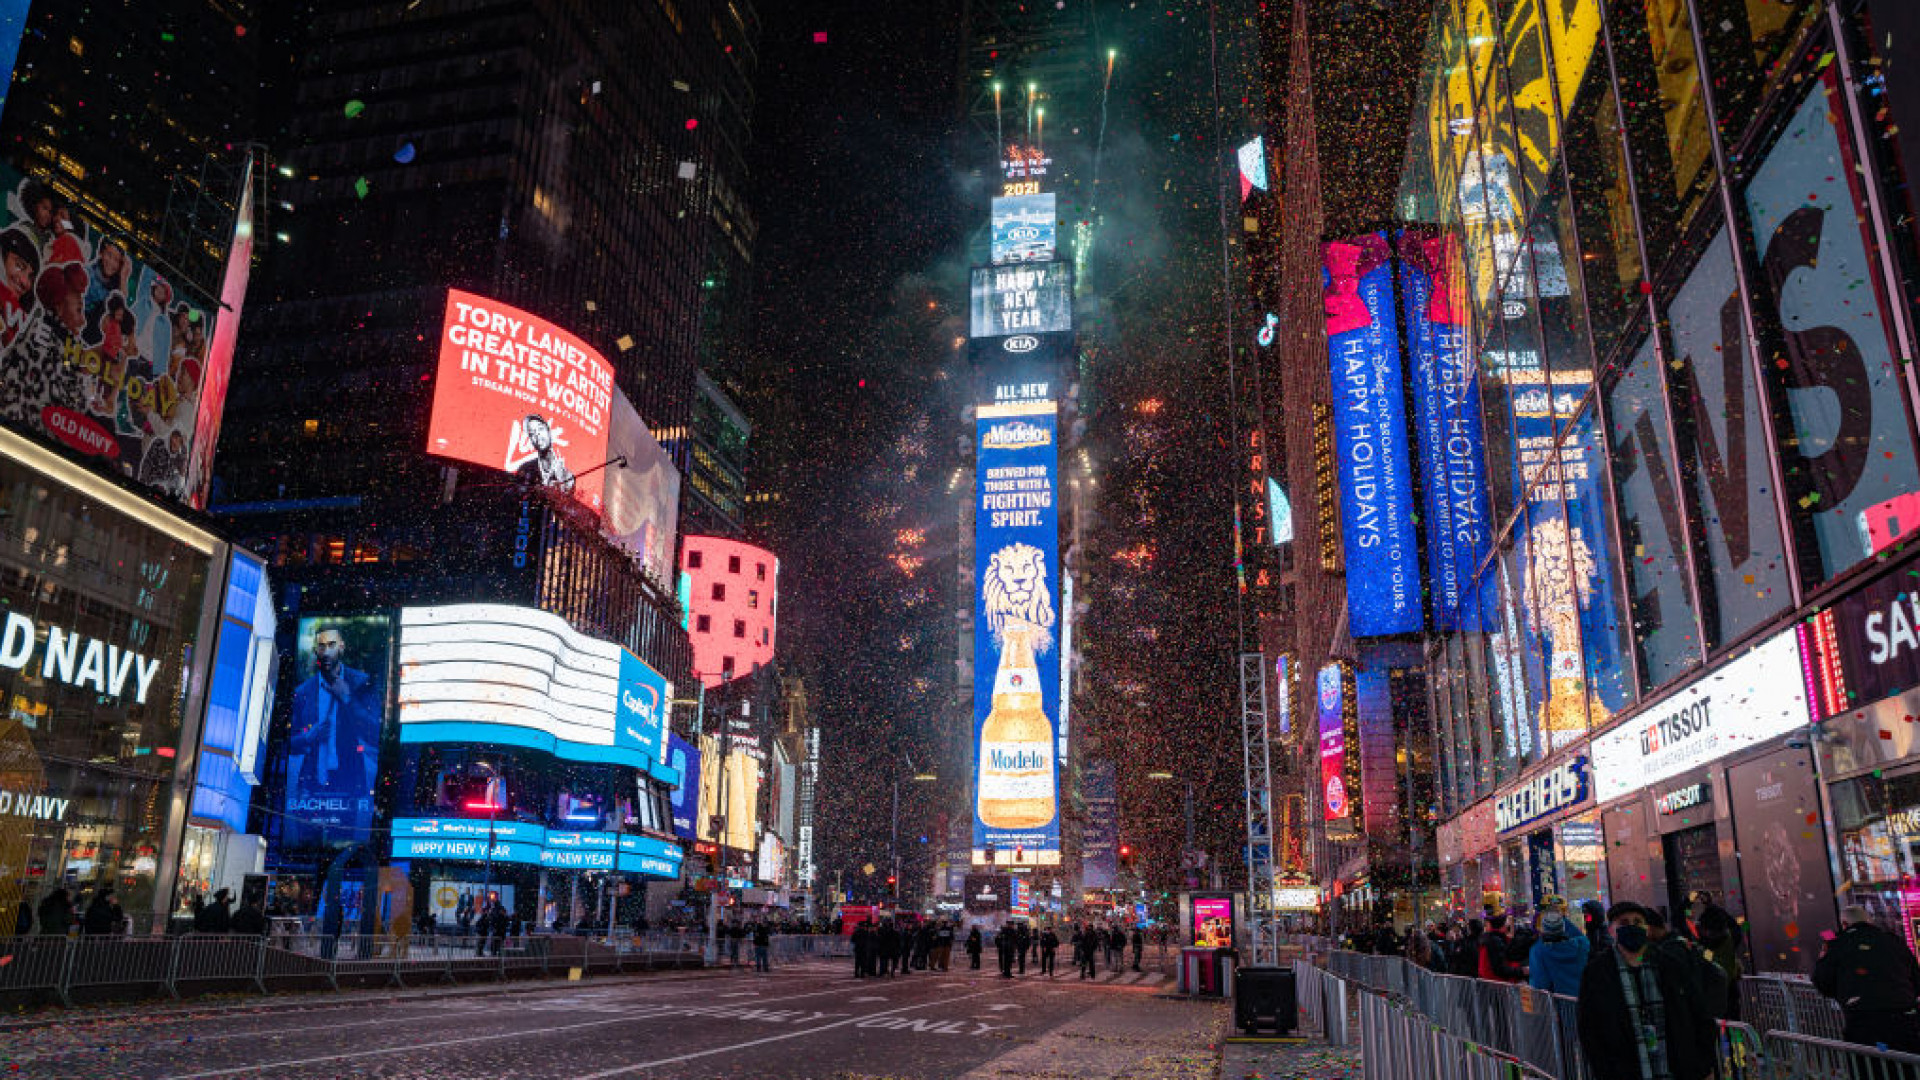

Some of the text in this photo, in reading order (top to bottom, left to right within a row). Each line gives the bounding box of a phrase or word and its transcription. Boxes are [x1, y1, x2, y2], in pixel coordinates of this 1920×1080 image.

[1003, 181, 1039, 197] 2021
[996, 270, 1046, 290] HAPPY
[1003, 290, 1036, 309] NEW
[1002, 309, 1041, 330] YEAR
[456, 302, 611, 392] TORY LANEZ THE
[64, 336, 177, 417] HOLIDAY
[449, 325, 611, 413] GREATEST ARTIST
[461, 350, 489, 375] IN
[496, 360, 540, 392] THE
[472, 376, 537, 404] STREAM NOW
[995, 382, 1048, 399] ALL-NEW
[51, 411, 113, 453] OLD NAVY
[990, 425, 1045, 443] Modelo
[1344, 338, 1381, 548] HAPPY HOLIDAYS
[987, 465, 1047, 479] BREWED FOR
[984, 478, 1051, 492] THOSE WITH A
[983, 491, 1051, 510] FIGHTING
[991, 510, 1043, 528] SPIRIT.
[1390, 544, 1401, 561] TO
[43, 625, 161, 704] NAVY
[1657, 695, 1711, 748] TISSOT
[990, 748, 1043, 771] Modelo
[1494, 757, 1579, 833] SKECHERS
[13, 791, 69, 821] NAVY
[411, 842, 444, 854] HAPPY
[447, 843, 476, 855] NEW
[557, 853, 581, 864] NEW
[585, 854, 613, 866] YEAR
